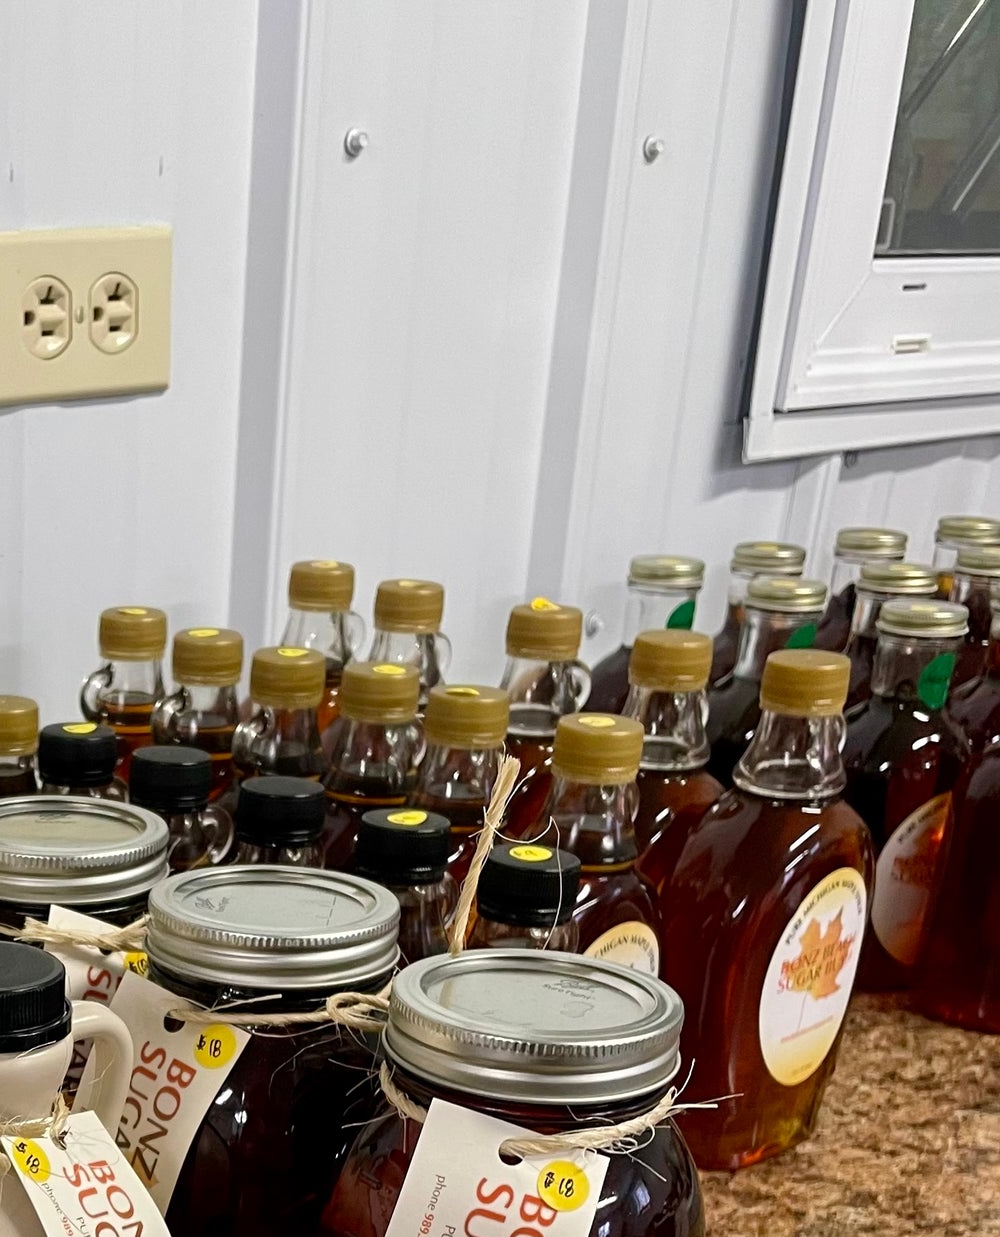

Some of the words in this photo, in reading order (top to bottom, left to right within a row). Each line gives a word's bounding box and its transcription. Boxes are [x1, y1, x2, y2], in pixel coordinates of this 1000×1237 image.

[196, 1033, 222, 1059] $18
[131, 1057, 198, 1182] BONZ
[40, 1181, 63, 1216] phone
[427, 1173, 446, 1211] phone
[543, 1171, 575, 1199] $18
